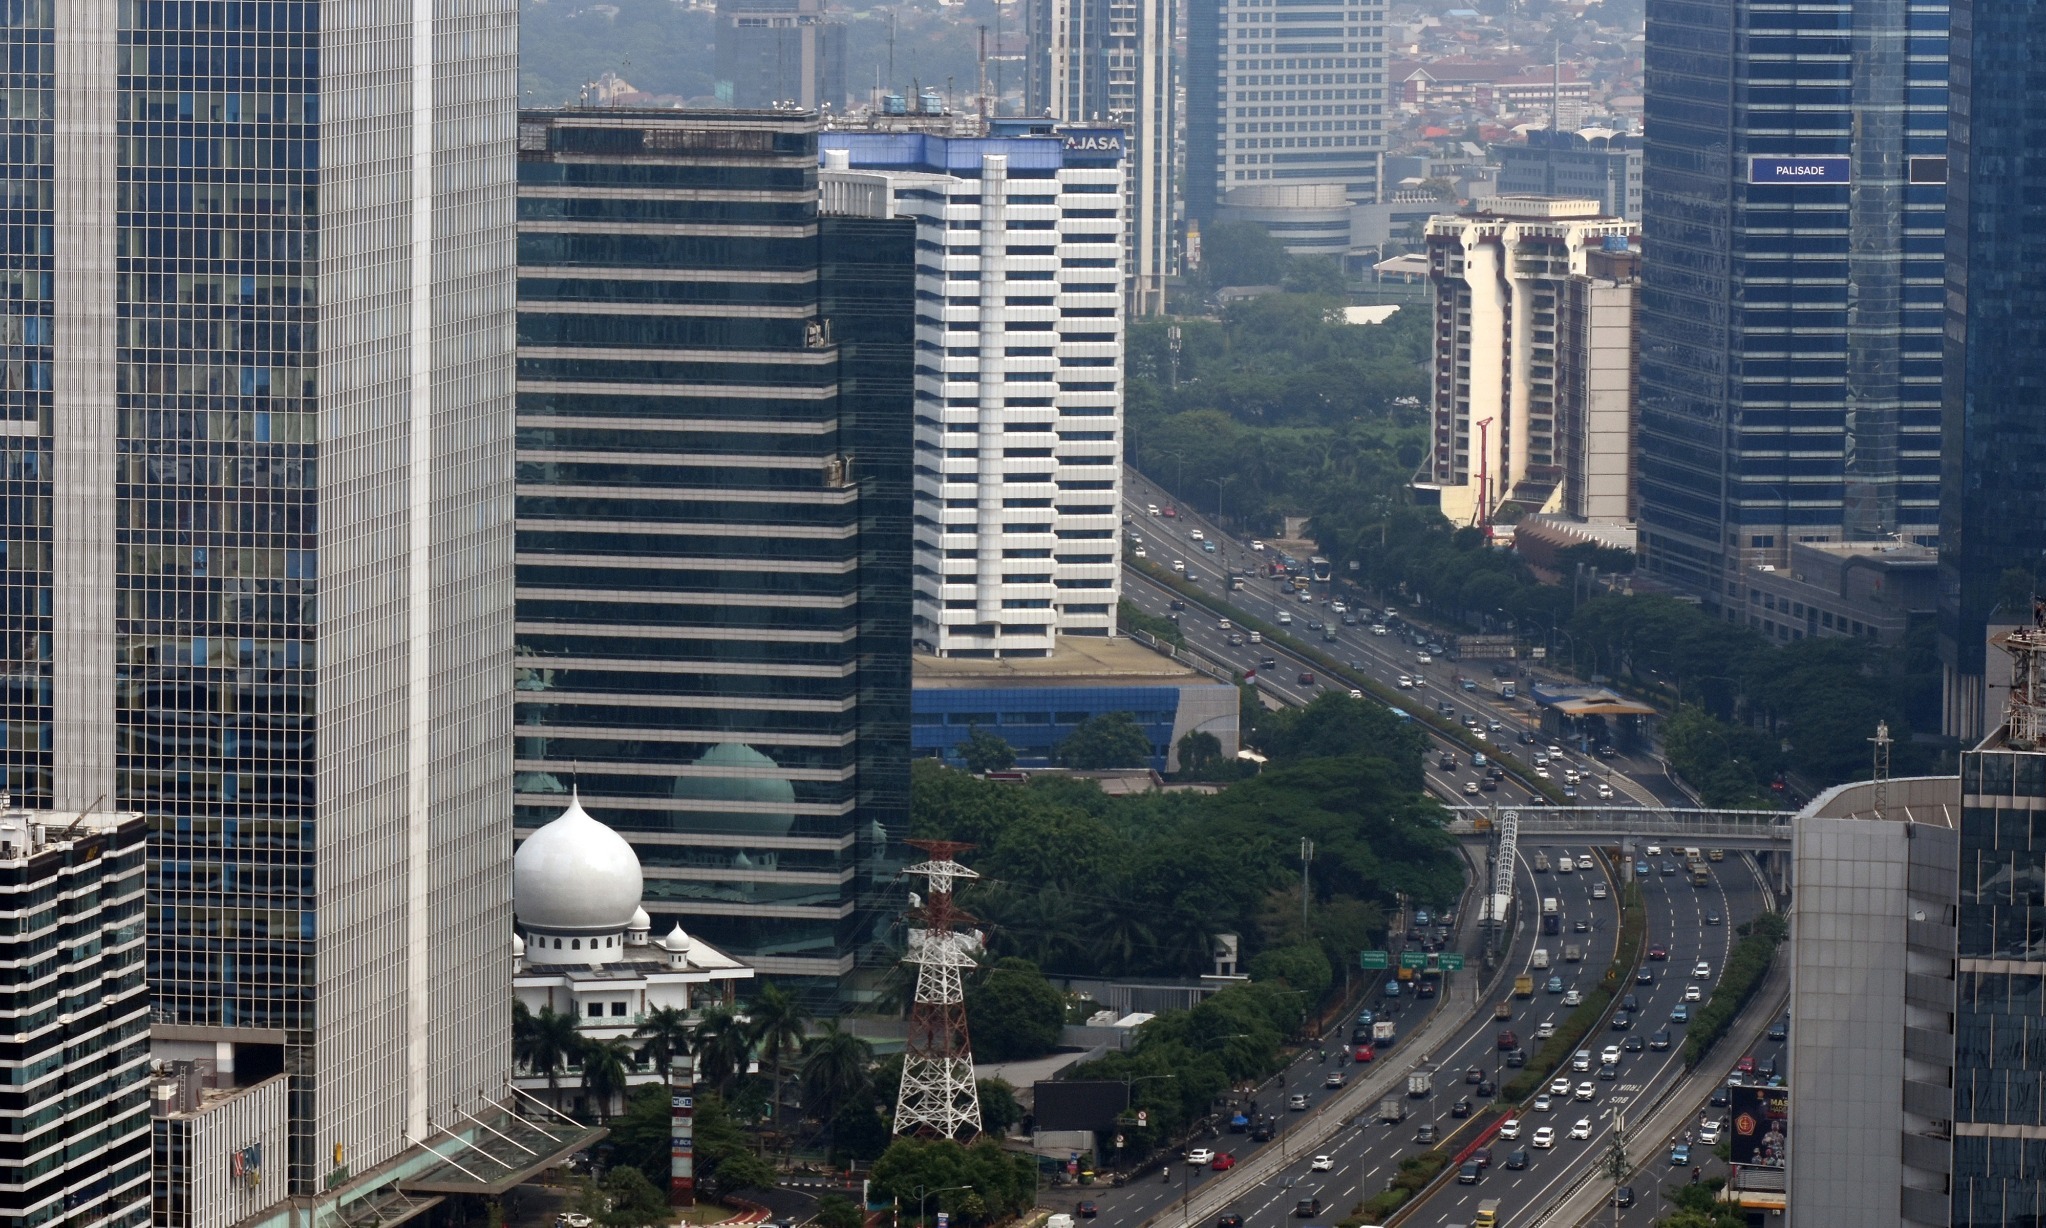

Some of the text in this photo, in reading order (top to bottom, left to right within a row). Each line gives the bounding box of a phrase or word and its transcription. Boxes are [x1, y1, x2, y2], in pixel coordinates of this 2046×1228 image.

[1063, 136, 1120, 150] AJASA
[1776, 166, 1825, 175] PALISADE
[672, 1098, 692, 1106] MOL
